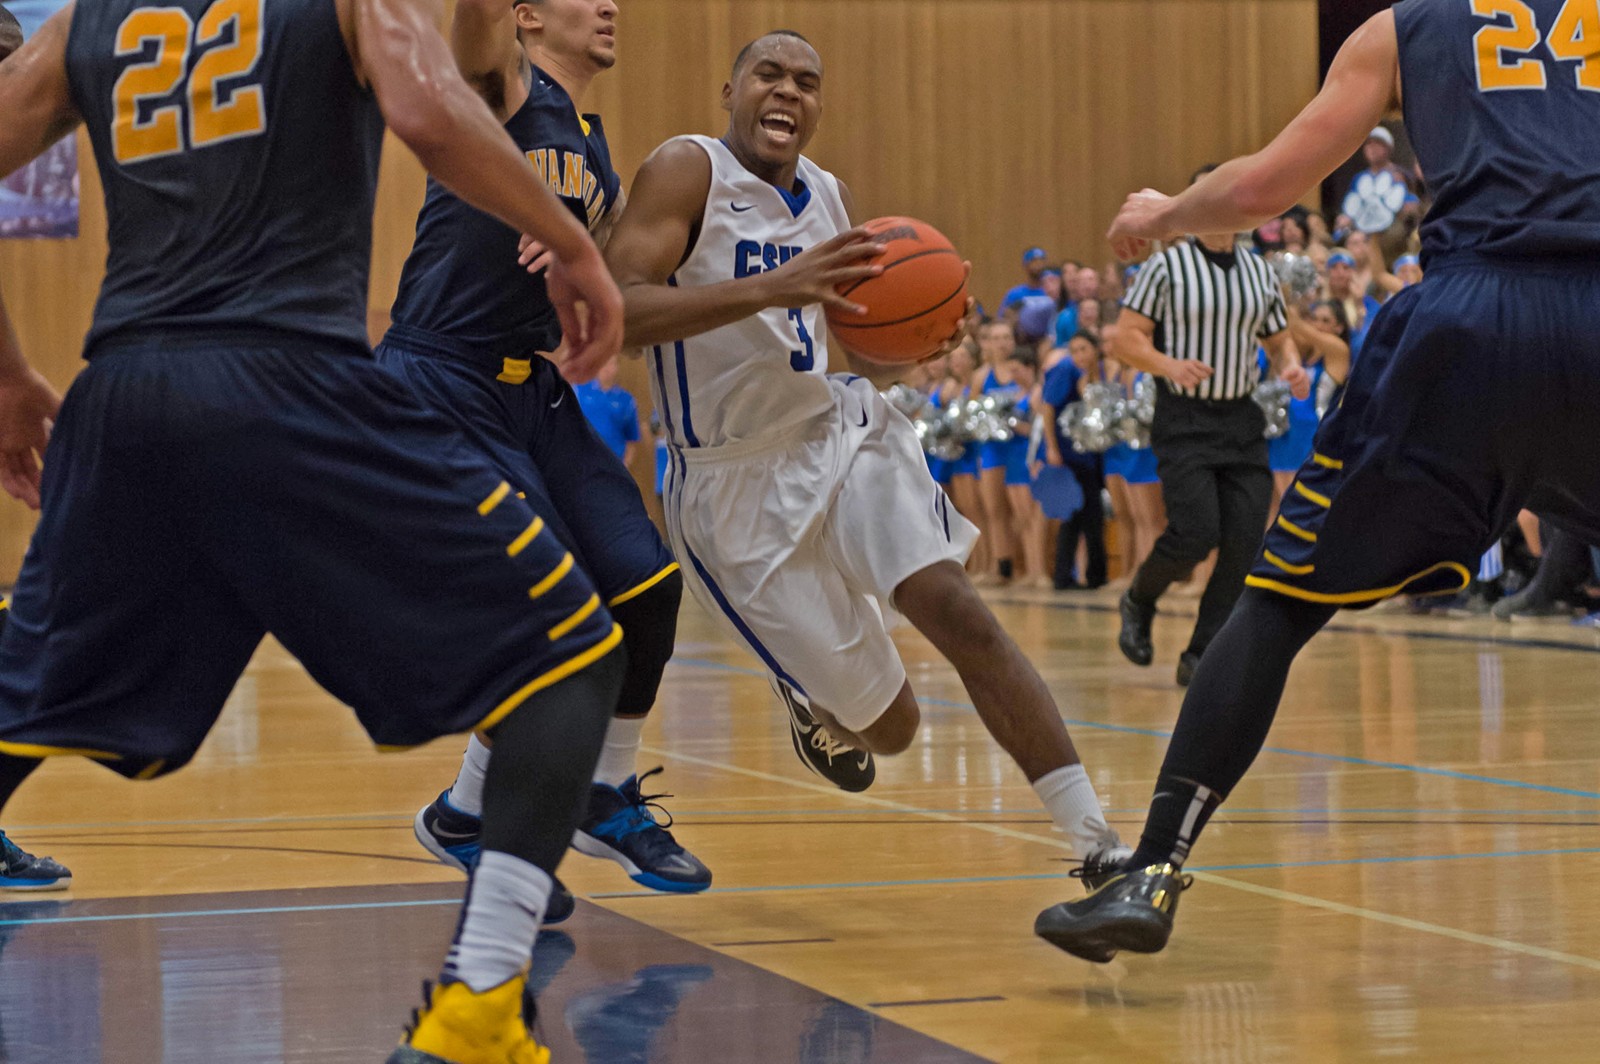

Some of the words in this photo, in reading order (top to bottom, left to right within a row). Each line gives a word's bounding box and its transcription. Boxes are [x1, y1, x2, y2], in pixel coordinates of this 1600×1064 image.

[111, 0, 267, 165] 22
[1469, 0, 1600, 92] 24
[788, 307, 814, 372] 3
